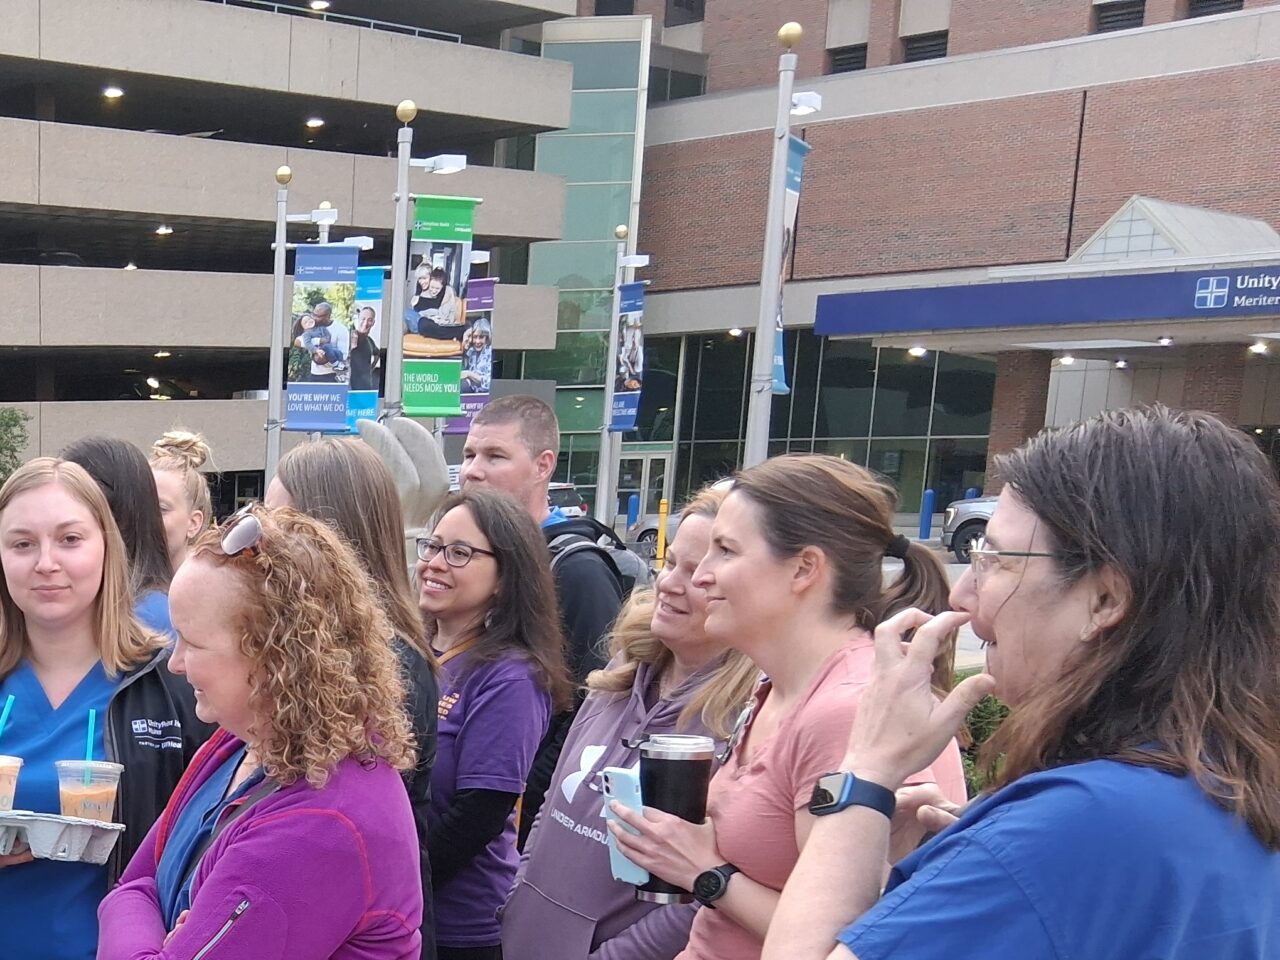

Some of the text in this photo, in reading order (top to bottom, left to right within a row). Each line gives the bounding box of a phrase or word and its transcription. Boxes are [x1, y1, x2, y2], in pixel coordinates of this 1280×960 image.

[1233, 294, 1280, 307] Meriter
[403, 373, 439, 382] THE WORLD
[404, 383, 424, 393] NEEDS
[425, 383, 442, 392] MORE
[288, 393, 340, 401] YOU'RE WHY WE
[288, 403, 302, 411] LOVE
[304, 403, 323, 411] WHAT
[323, 403, 333, 411] WE
[550, 808, 609, 845] UNDER ARMOU
